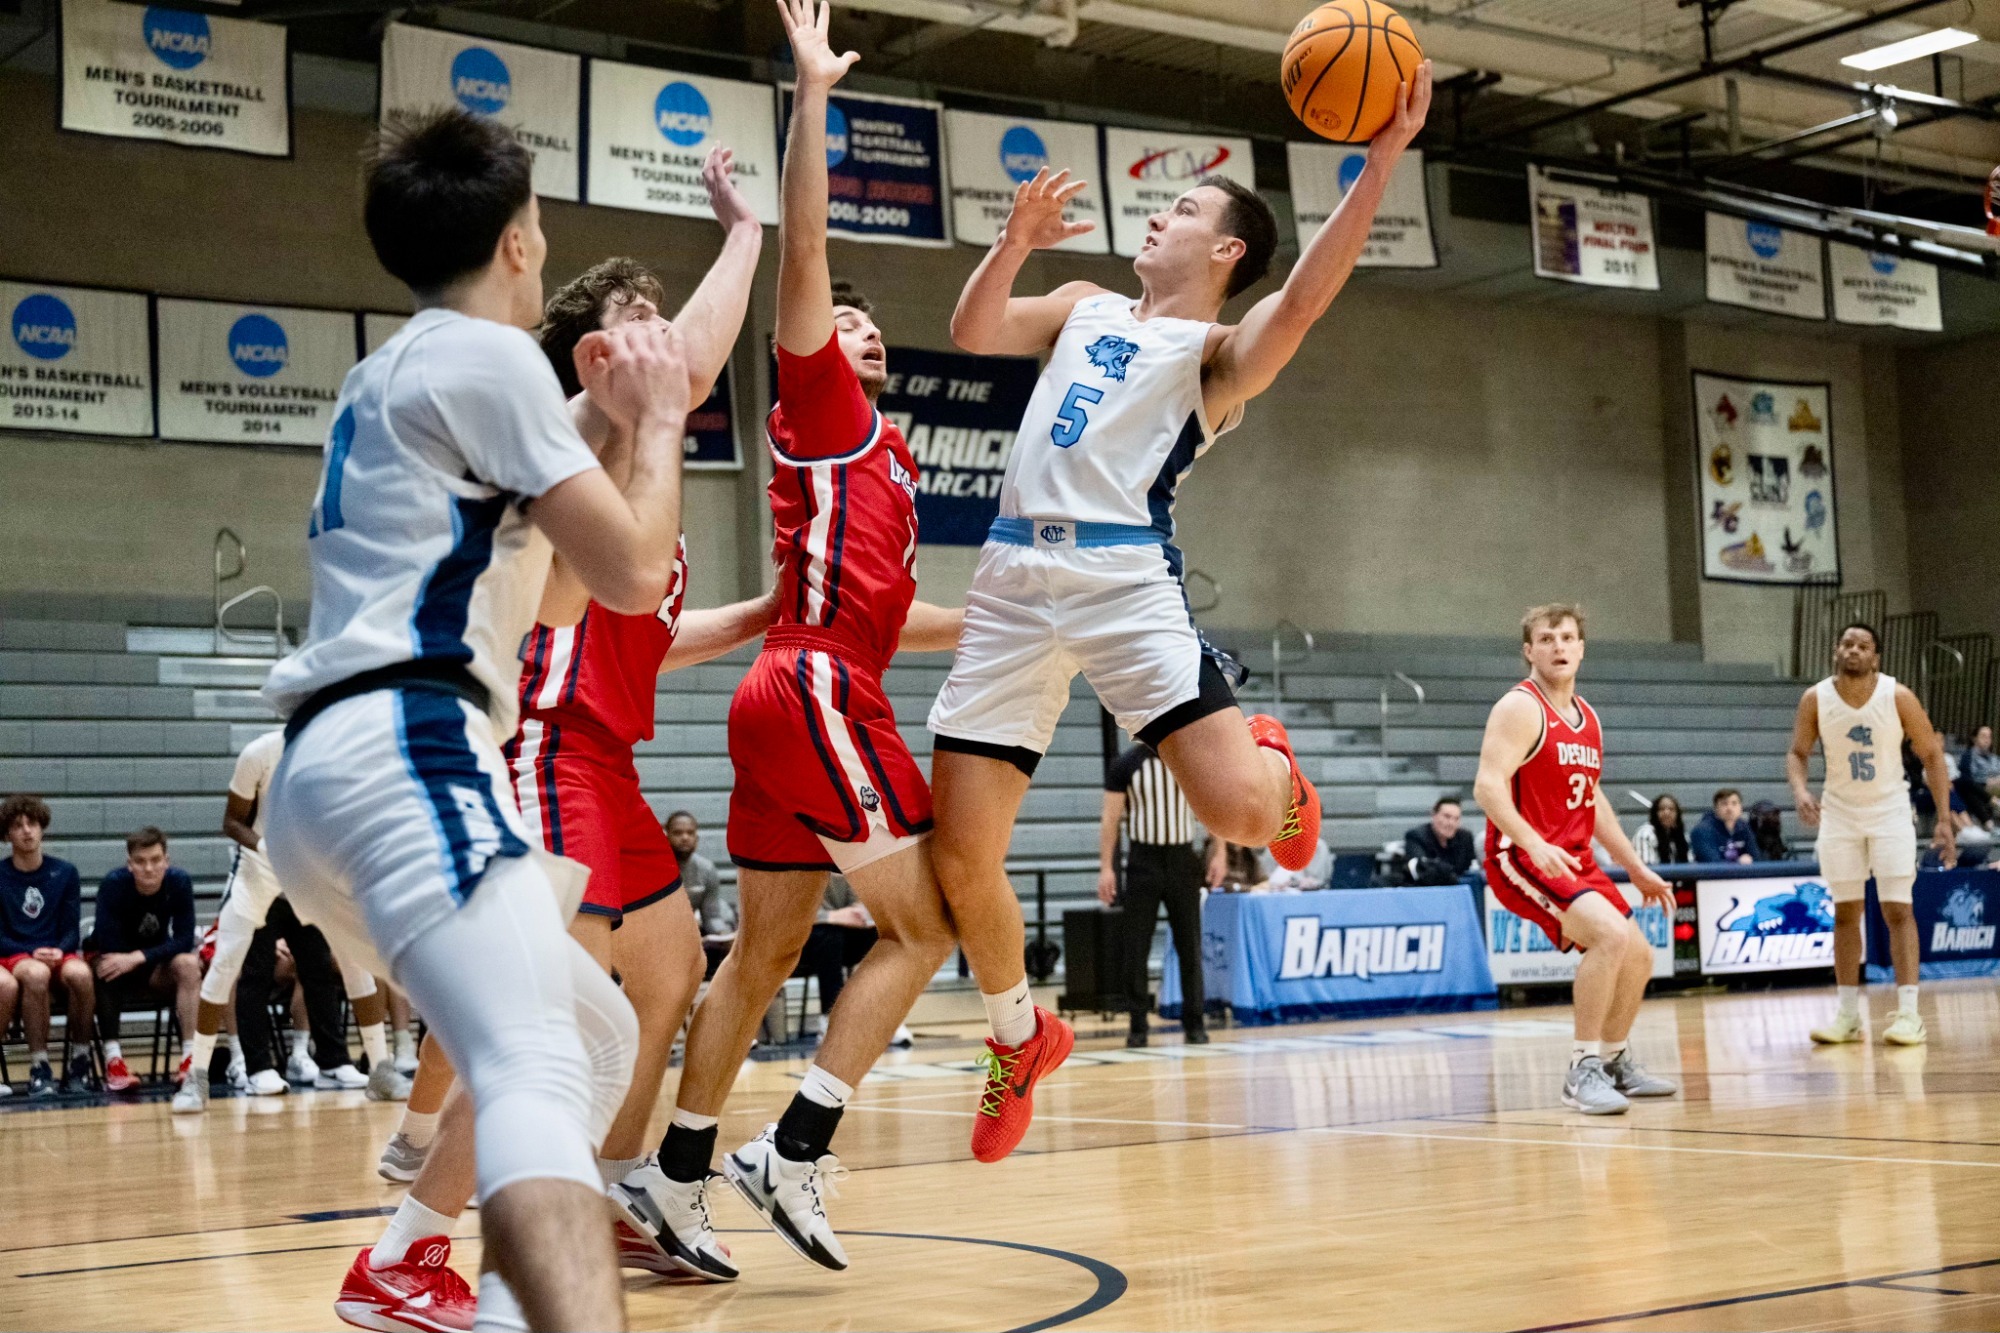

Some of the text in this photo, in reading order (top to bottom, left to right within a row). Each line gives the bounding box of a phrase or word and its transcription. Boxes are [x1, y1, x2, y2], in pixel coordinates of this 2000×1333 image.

[150, 29, 209, 53] NCAA
[85, 65, 266, 102] MEN'S BASKETBALL
[455, 75, 511, 101] NCAA
[114, 89, 241, 118] TOURNAMENT
[660, 110, 712, 134] NCAA
[609, 144, 760, 177] MEN'S BASKALL
[18, 324, 75, 345] NCAA
[234, 344, 288, 362] NCAA
[35, 367, 144, 389] BASKETBALL
[180, 380, 232, 396] MEN'S
[906, 375, 942, 398] OF
[948, 378, 994, 403] THE
[0, 385, 106, 404] OURNAMENT
[205, 399, 318, 418] TOURNAMENT
[1051, 381, 1105, 449] 5
[242, 419, 282, 433] 2014
[1848, 750, 1876, 782] 15
[1274, 914, 1446, 983] BARUCH
[1931, 921, 1996, 953] BARUCH
